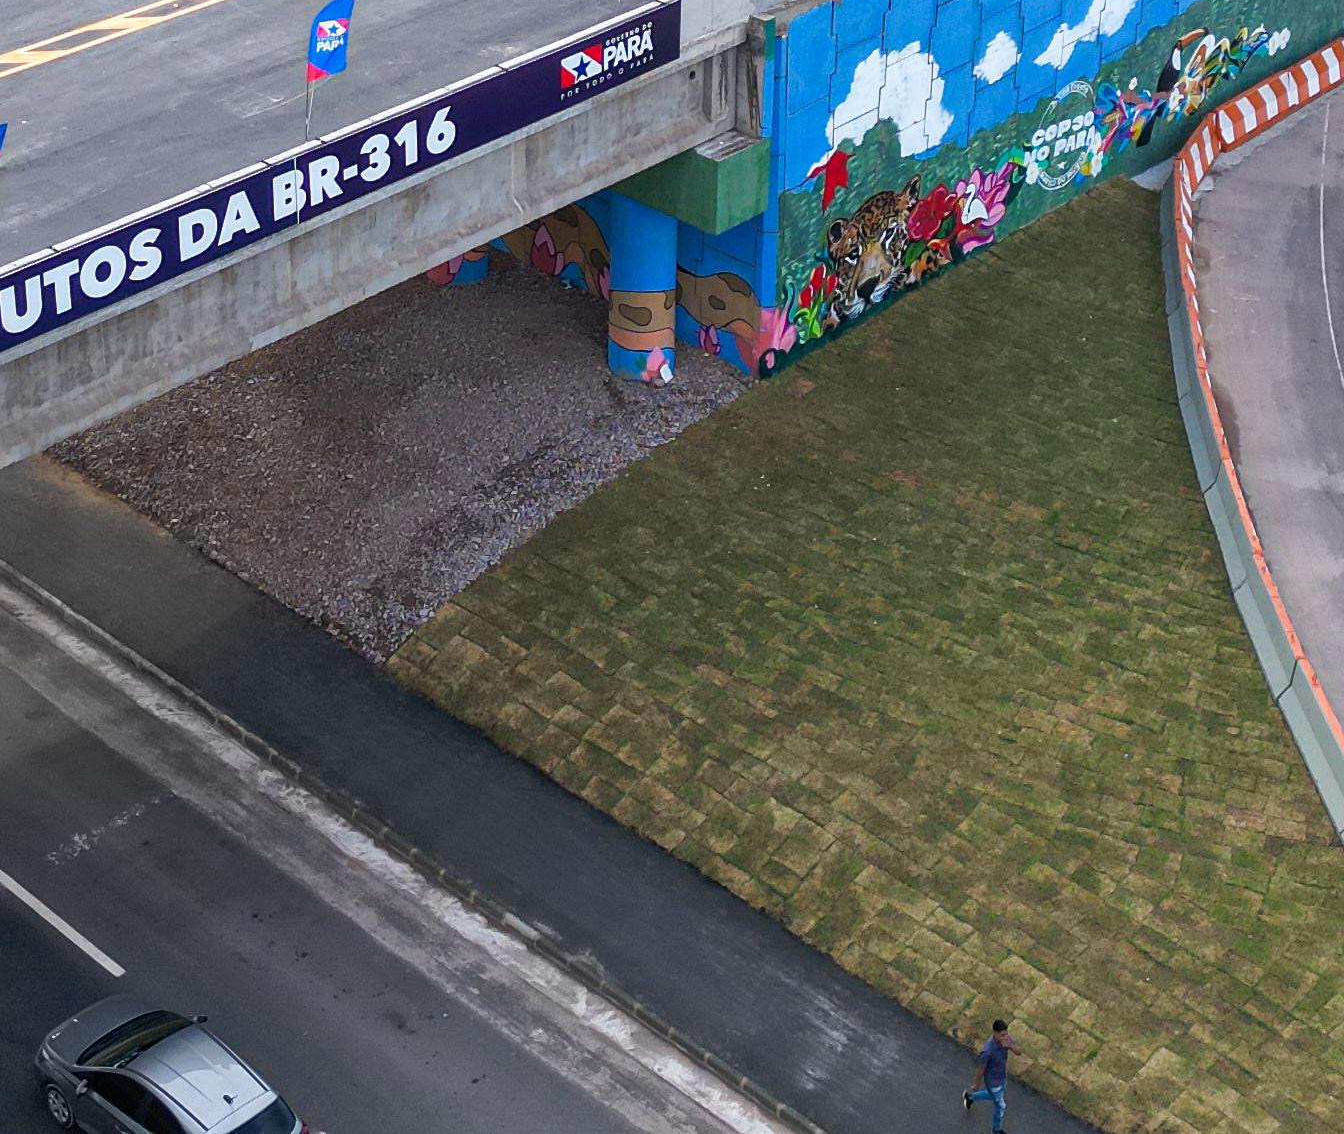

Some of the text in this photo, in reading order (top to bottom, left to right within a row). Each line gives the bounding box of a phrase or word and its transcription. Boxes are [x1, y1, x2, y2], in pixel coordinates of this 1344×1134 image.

[603, 28, 654, 71] PARÁ
[1022, 145, 1051, 168] NO
[176, 188, 260, 262] DA
[270, 106, 458, 224] BR-316
